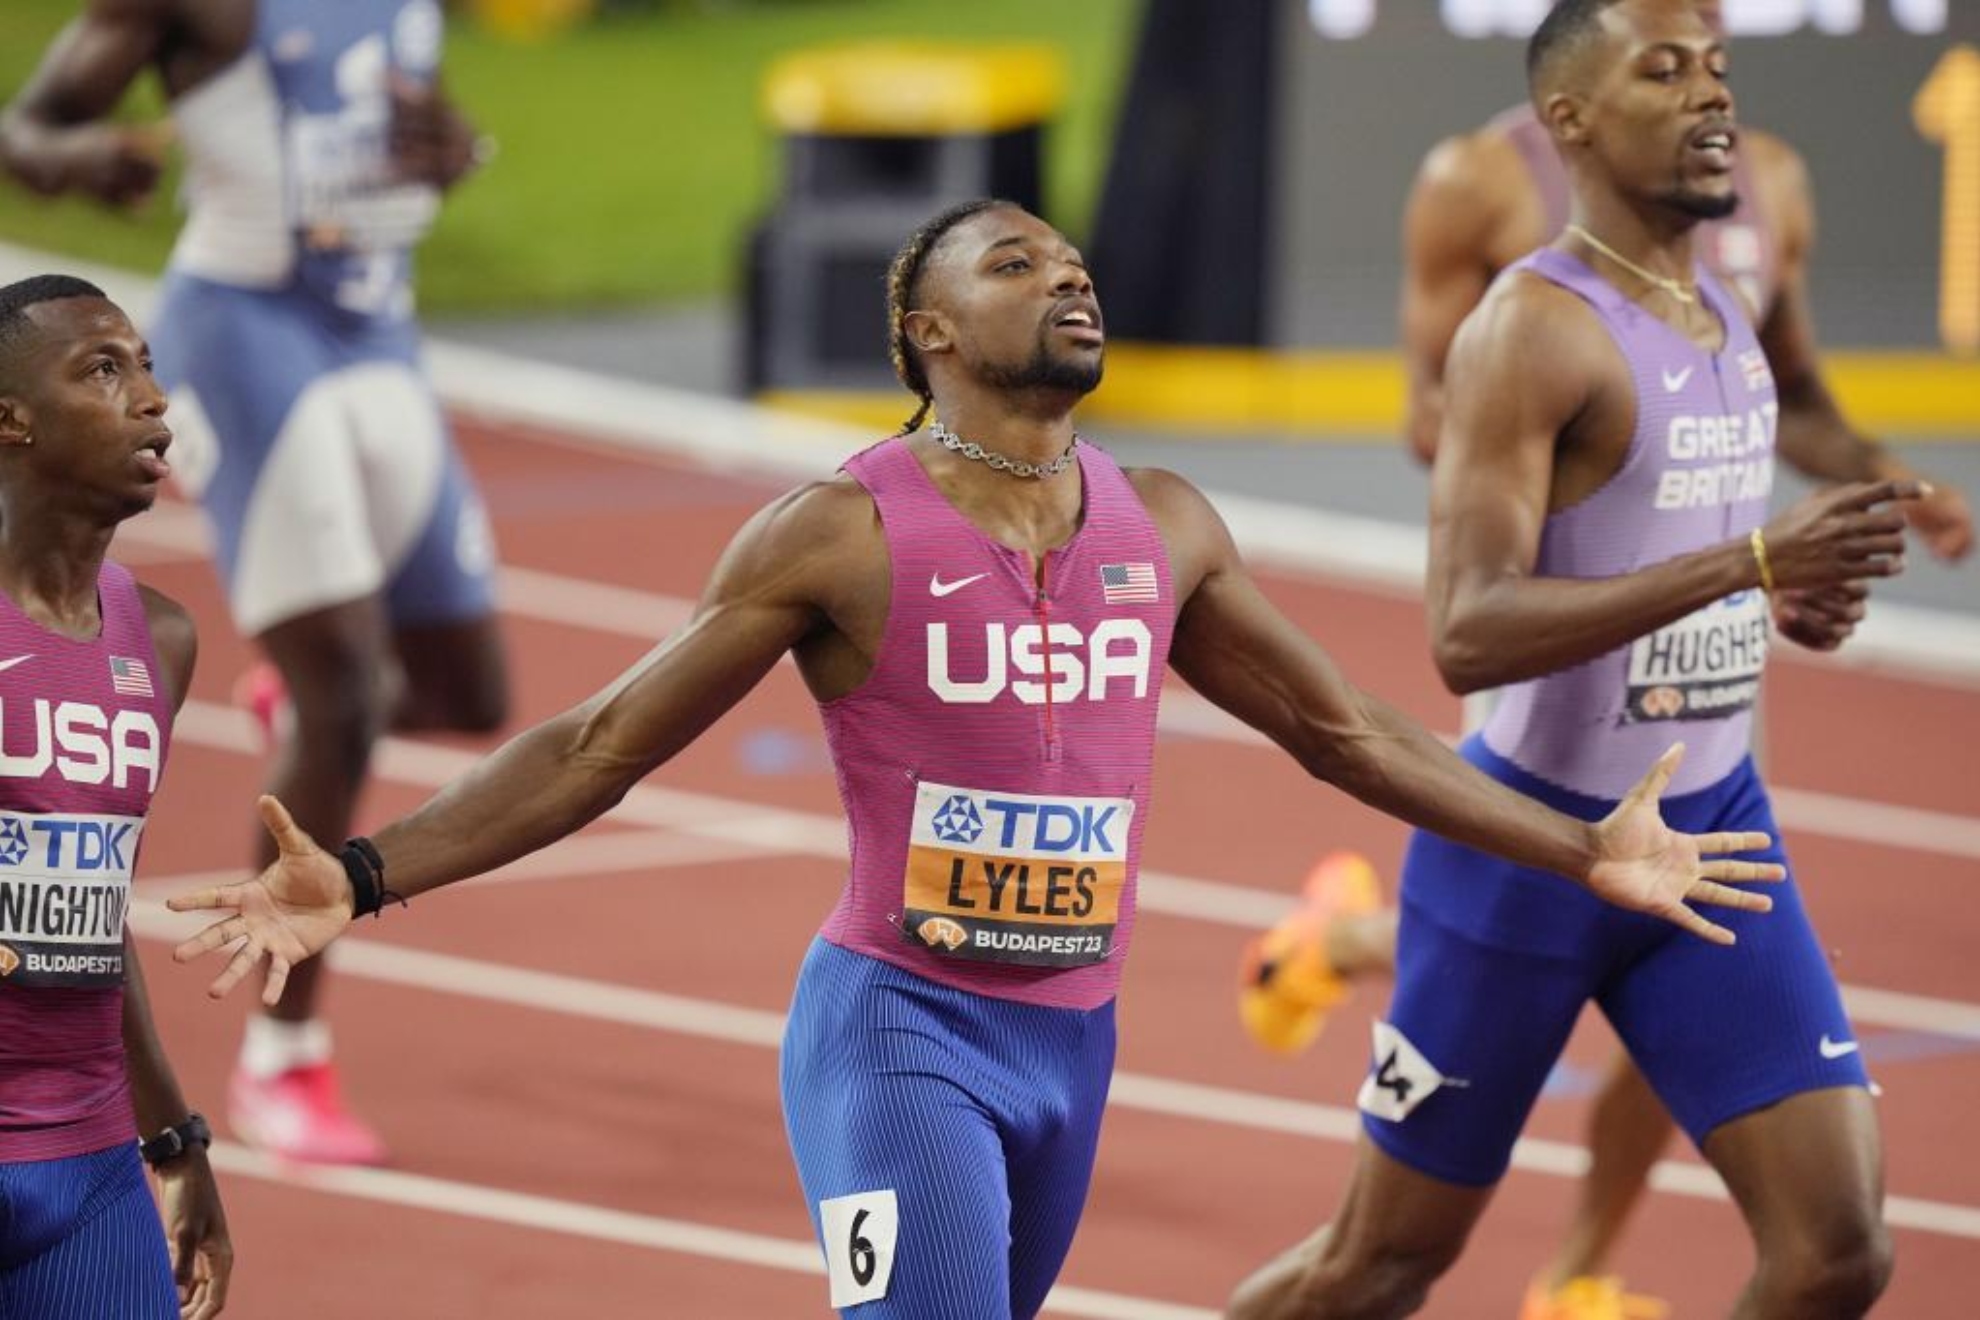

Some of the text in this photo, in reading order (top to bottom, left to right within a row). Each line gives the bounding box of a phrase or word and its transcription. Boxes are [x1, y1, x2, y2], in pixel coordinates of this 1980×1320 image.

[927, 619, 1151, 703] USA
[0, 697, 160, 792] USA
[32, 821, 132, 869] TDK
[986, 799, 1118, 852] TDK
[947, 857, 1098, 917] LYLES
[1376, 1047, 1413, 1103] 4
[849, 1208, 876, 1287] 6
